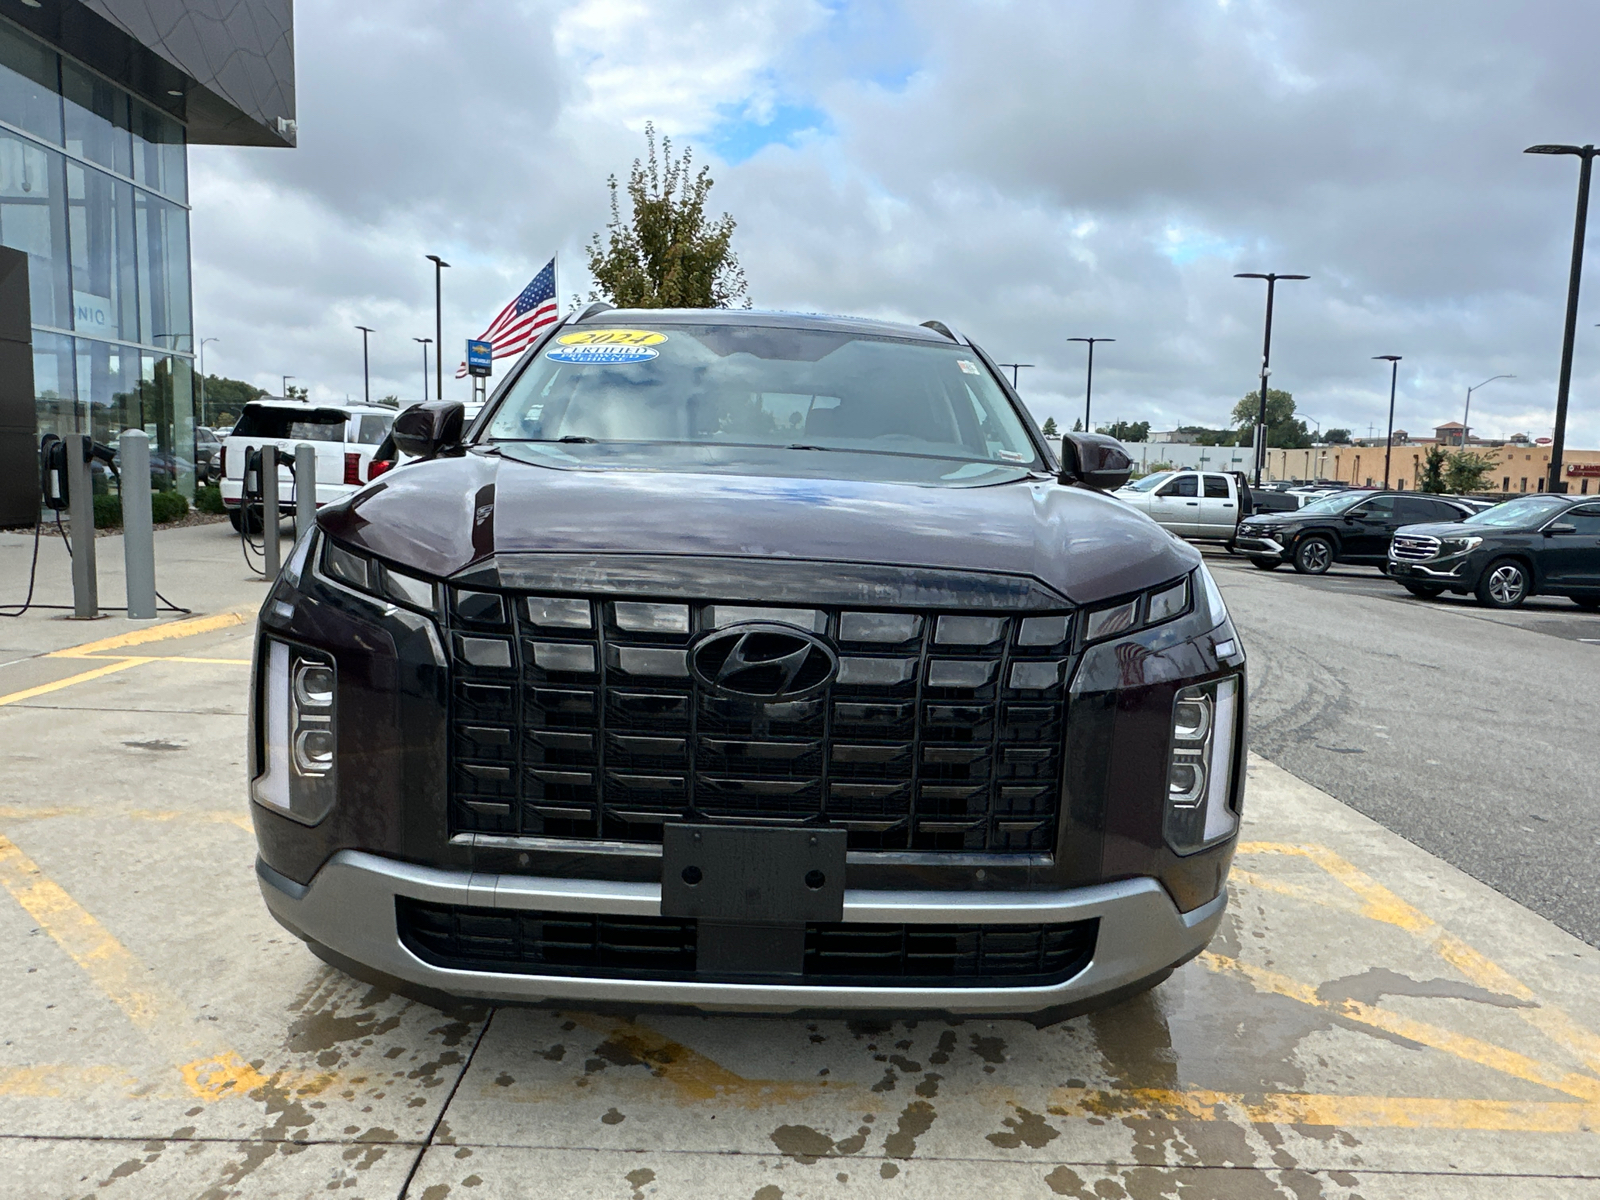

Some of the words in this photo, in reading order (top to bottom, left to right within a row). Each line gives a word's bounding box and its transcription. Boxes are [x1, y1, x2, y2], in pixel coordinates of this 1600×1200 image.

[74, 305, 105, 326] NIQ
[570, 333, 654, 345] 2024
[561, 346, 648, 354] CERTIFIED
